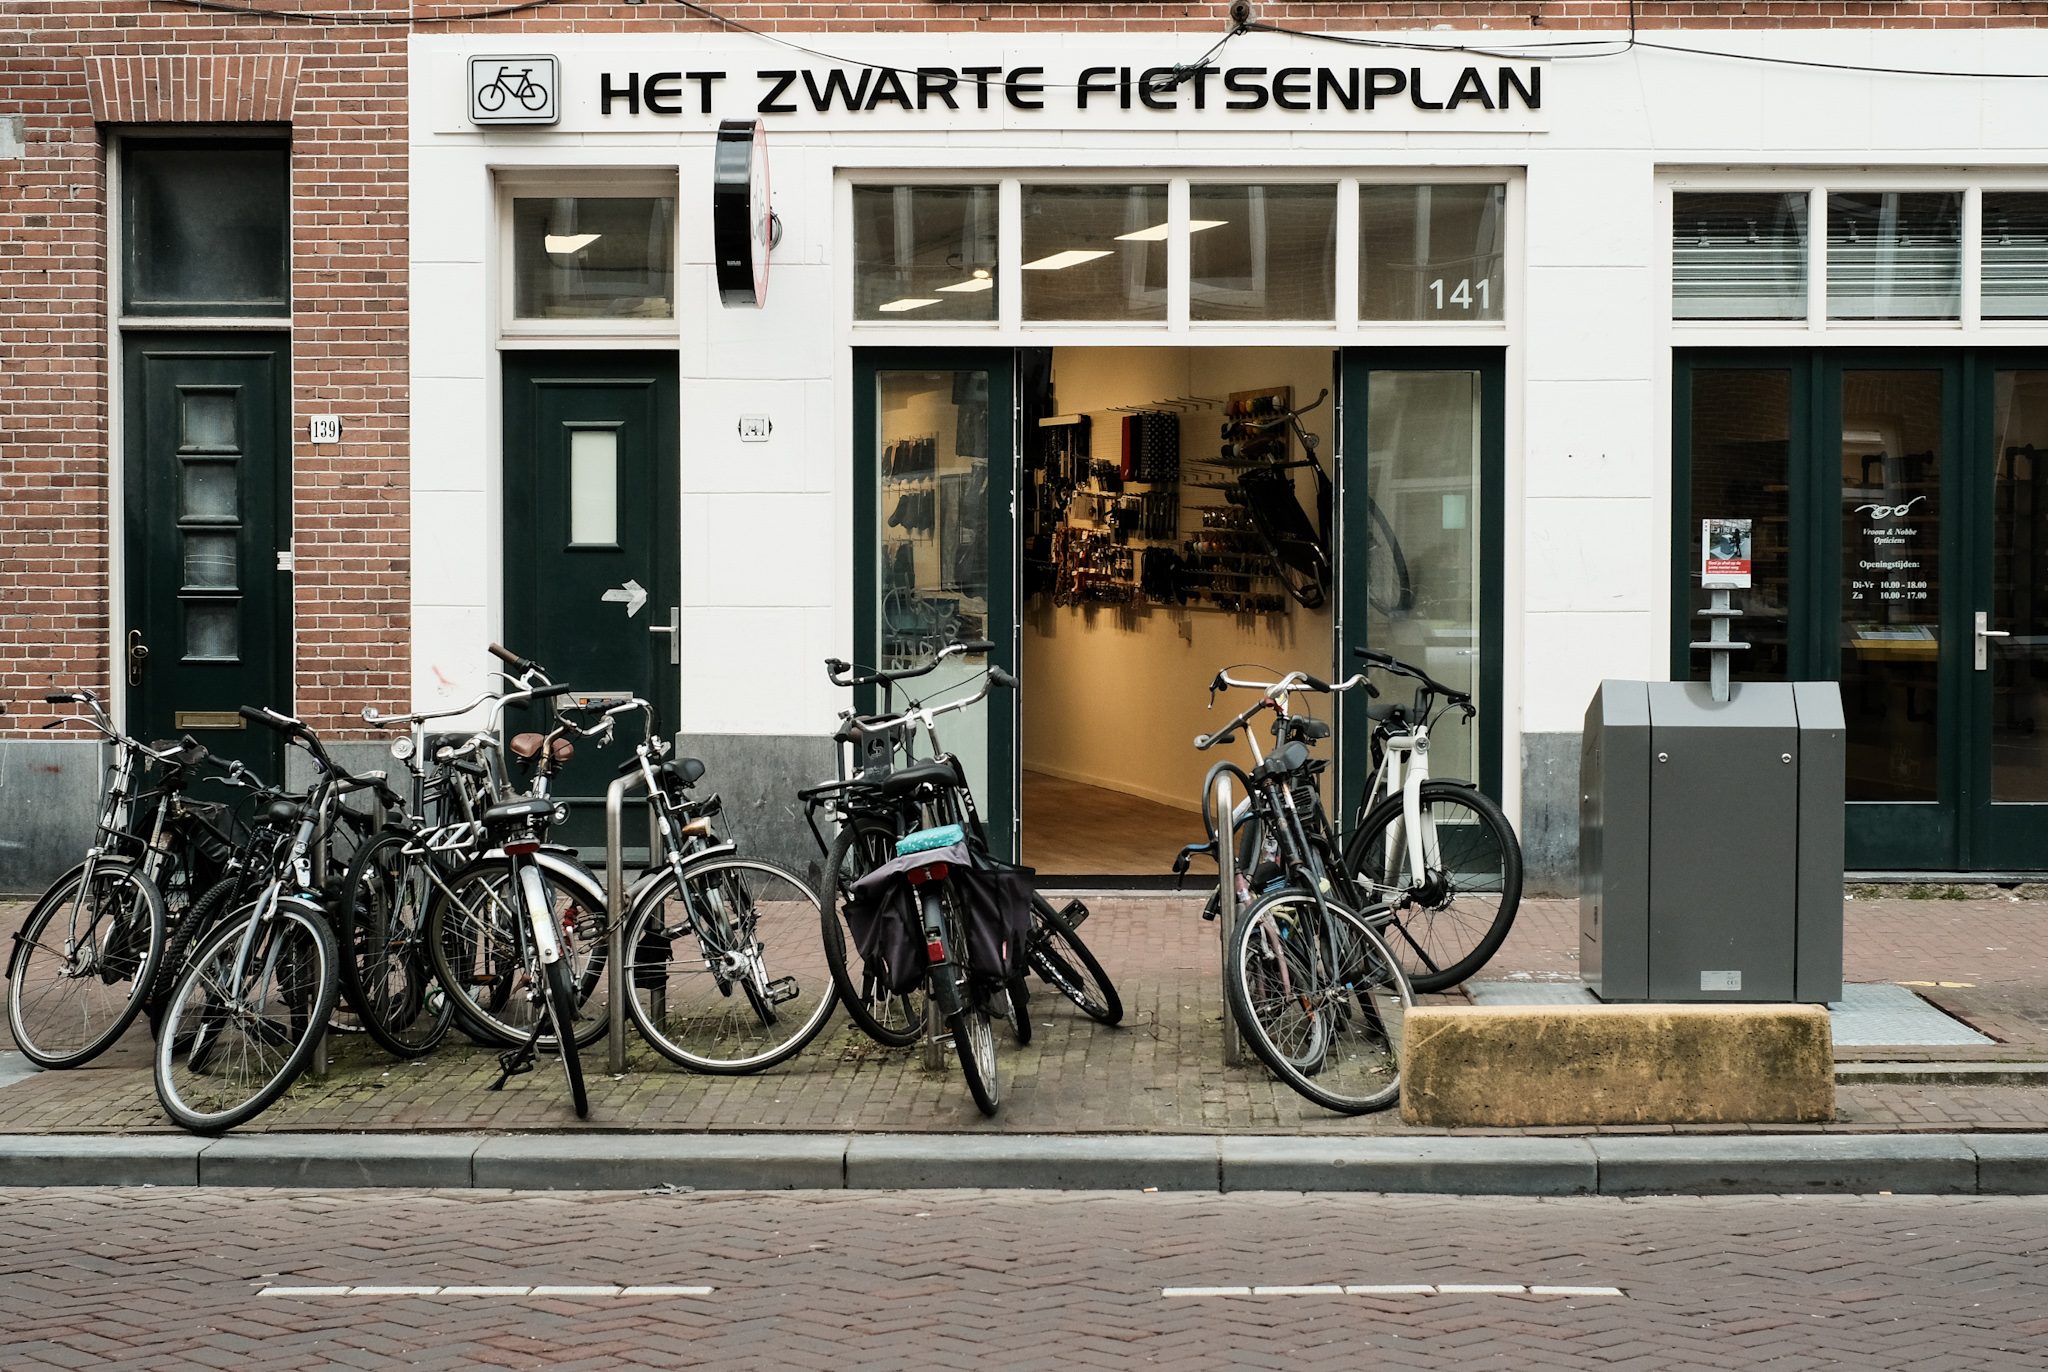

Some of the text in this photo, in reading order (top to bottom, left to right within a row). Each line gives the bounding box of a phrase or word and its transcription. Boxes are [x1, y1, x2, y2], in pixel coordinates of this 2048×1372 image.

[601, 66, 1541, 114] HET ZWARTE FIETSENPLAN
[1429, 278, 1489, 309] 141
[313, 420, 336, 438] 139
[1873, 536, 1905, 545] Opticiens
[1859, 560, 1920, 570] Openingstijden:
[1852, 581, 1875, 589] Di-Vr
[1880, 581, 1900, 589] 10.00
[1907, 581, 1927, 589] 18.00
[1852, 591, 1863, 599] Za
[1880, 591, 1900, 599] 10.00
[1907, 591, 1927, 599] 17.00
